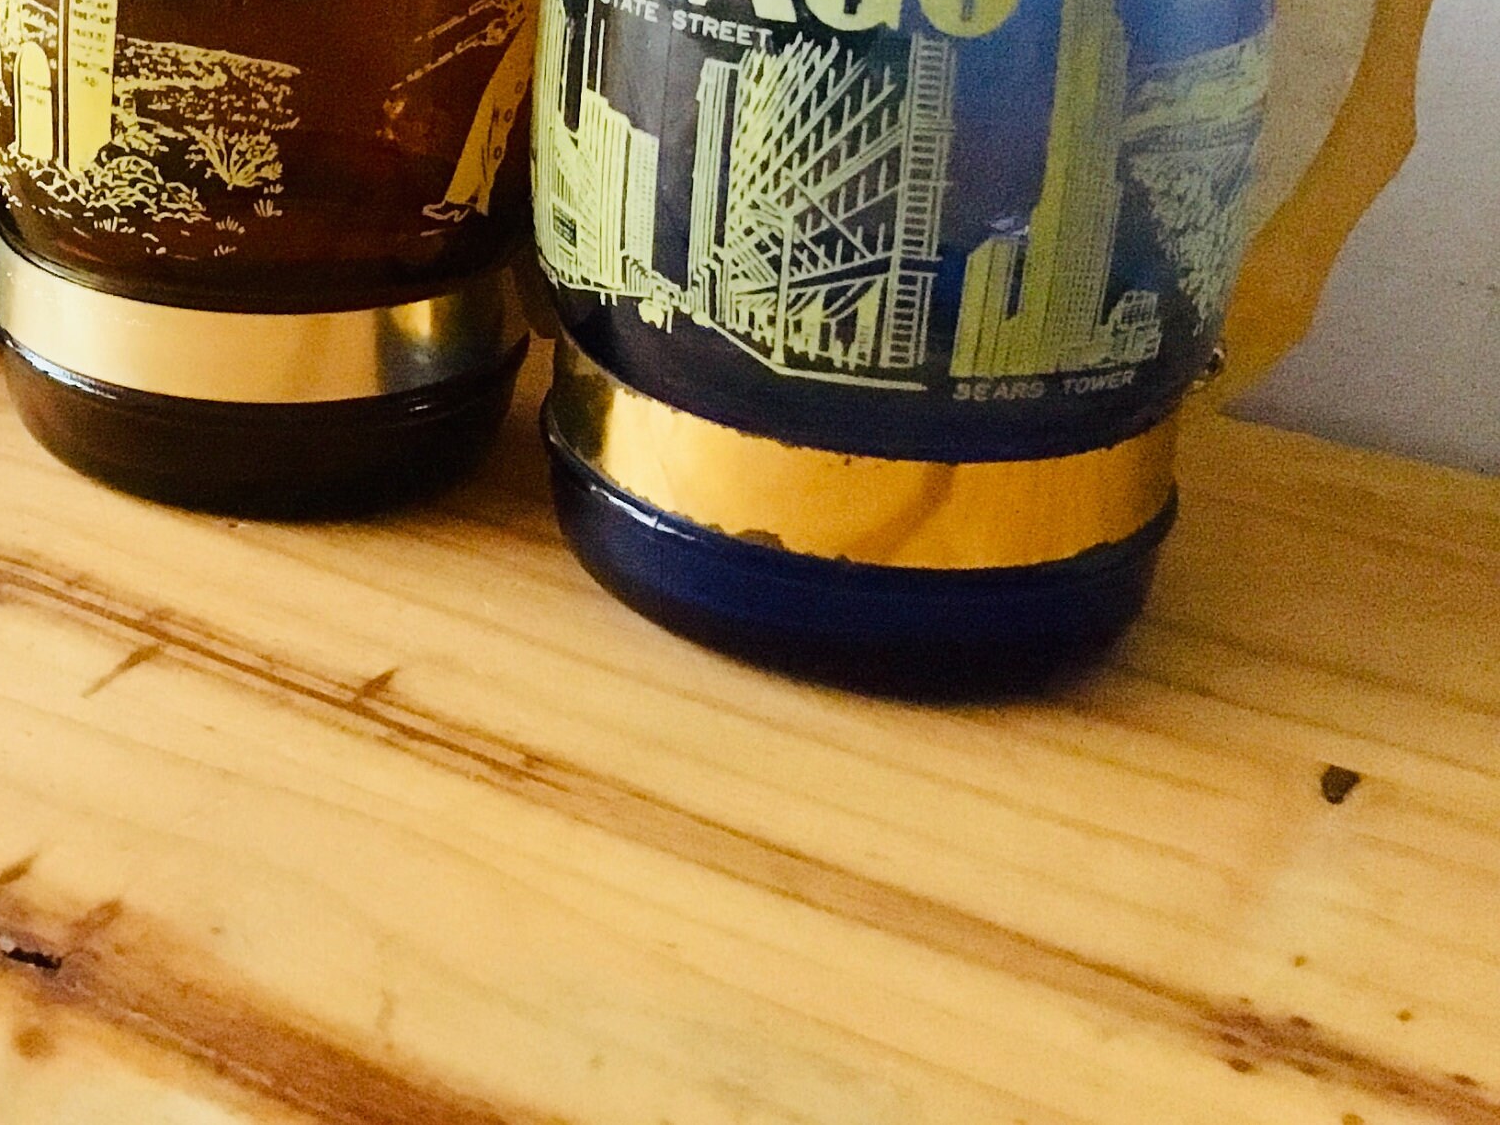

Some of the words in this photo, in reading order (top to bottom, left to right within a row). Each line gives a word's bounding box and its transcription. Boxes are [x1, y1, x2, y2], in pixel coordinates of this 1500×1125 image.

[672, 9, 773, 48] STREET
[953, 382, 1046, 402] SEARS
[1062, 369, 1135, 395] TOWER
